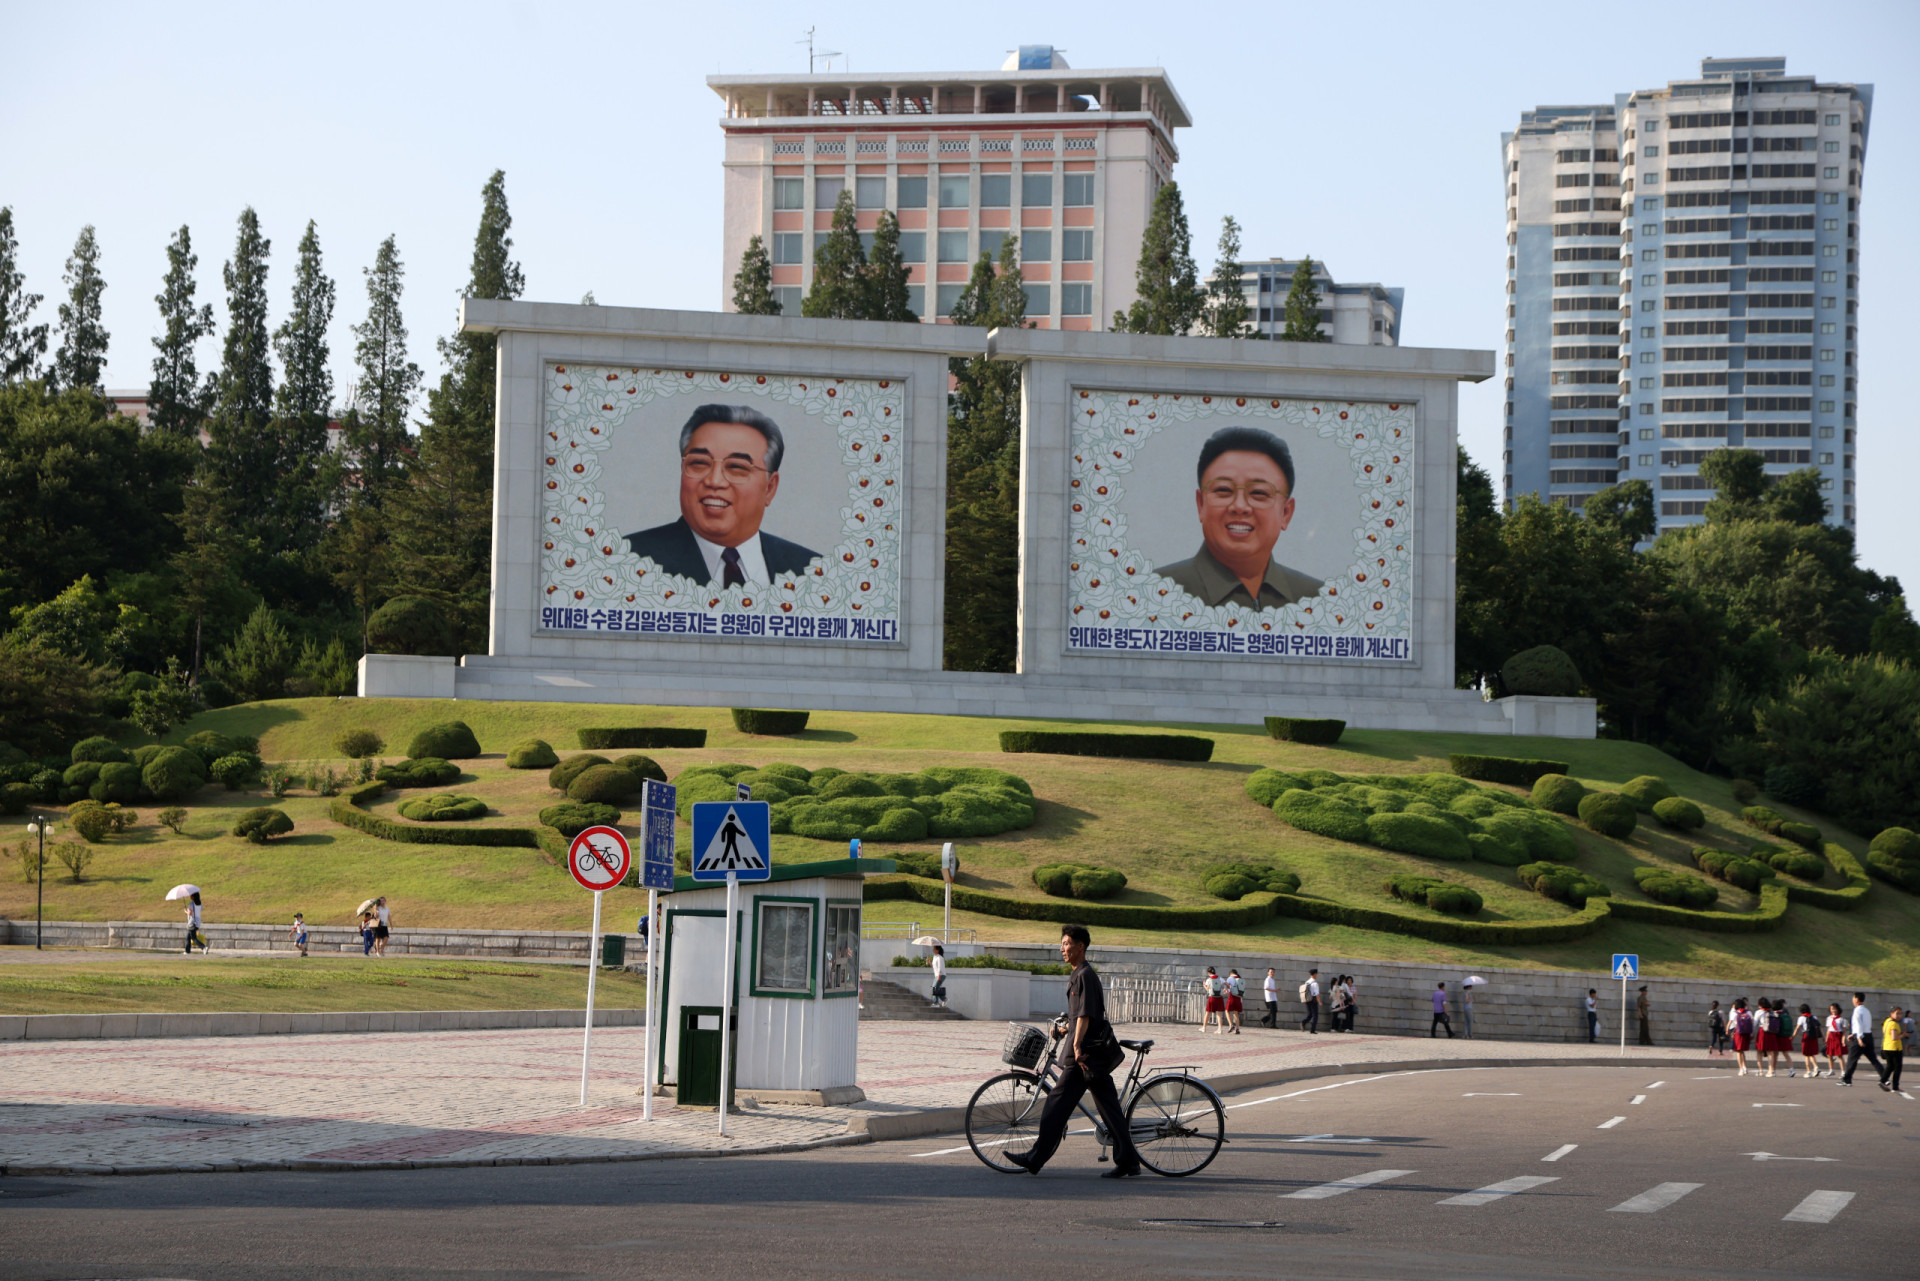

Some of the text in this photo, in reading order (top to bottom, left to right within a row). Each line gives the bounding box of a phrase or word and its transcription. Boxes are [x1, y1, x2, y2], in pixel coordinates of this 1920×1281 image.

[542, 607, 897, 640] 위대한 수령 김일성동지는 영원히 우리와 함께 계신다
[1069, 626, 1409, 659] 위대한 령도자 김정일동지는 영원히 우리와 함께 계신다
